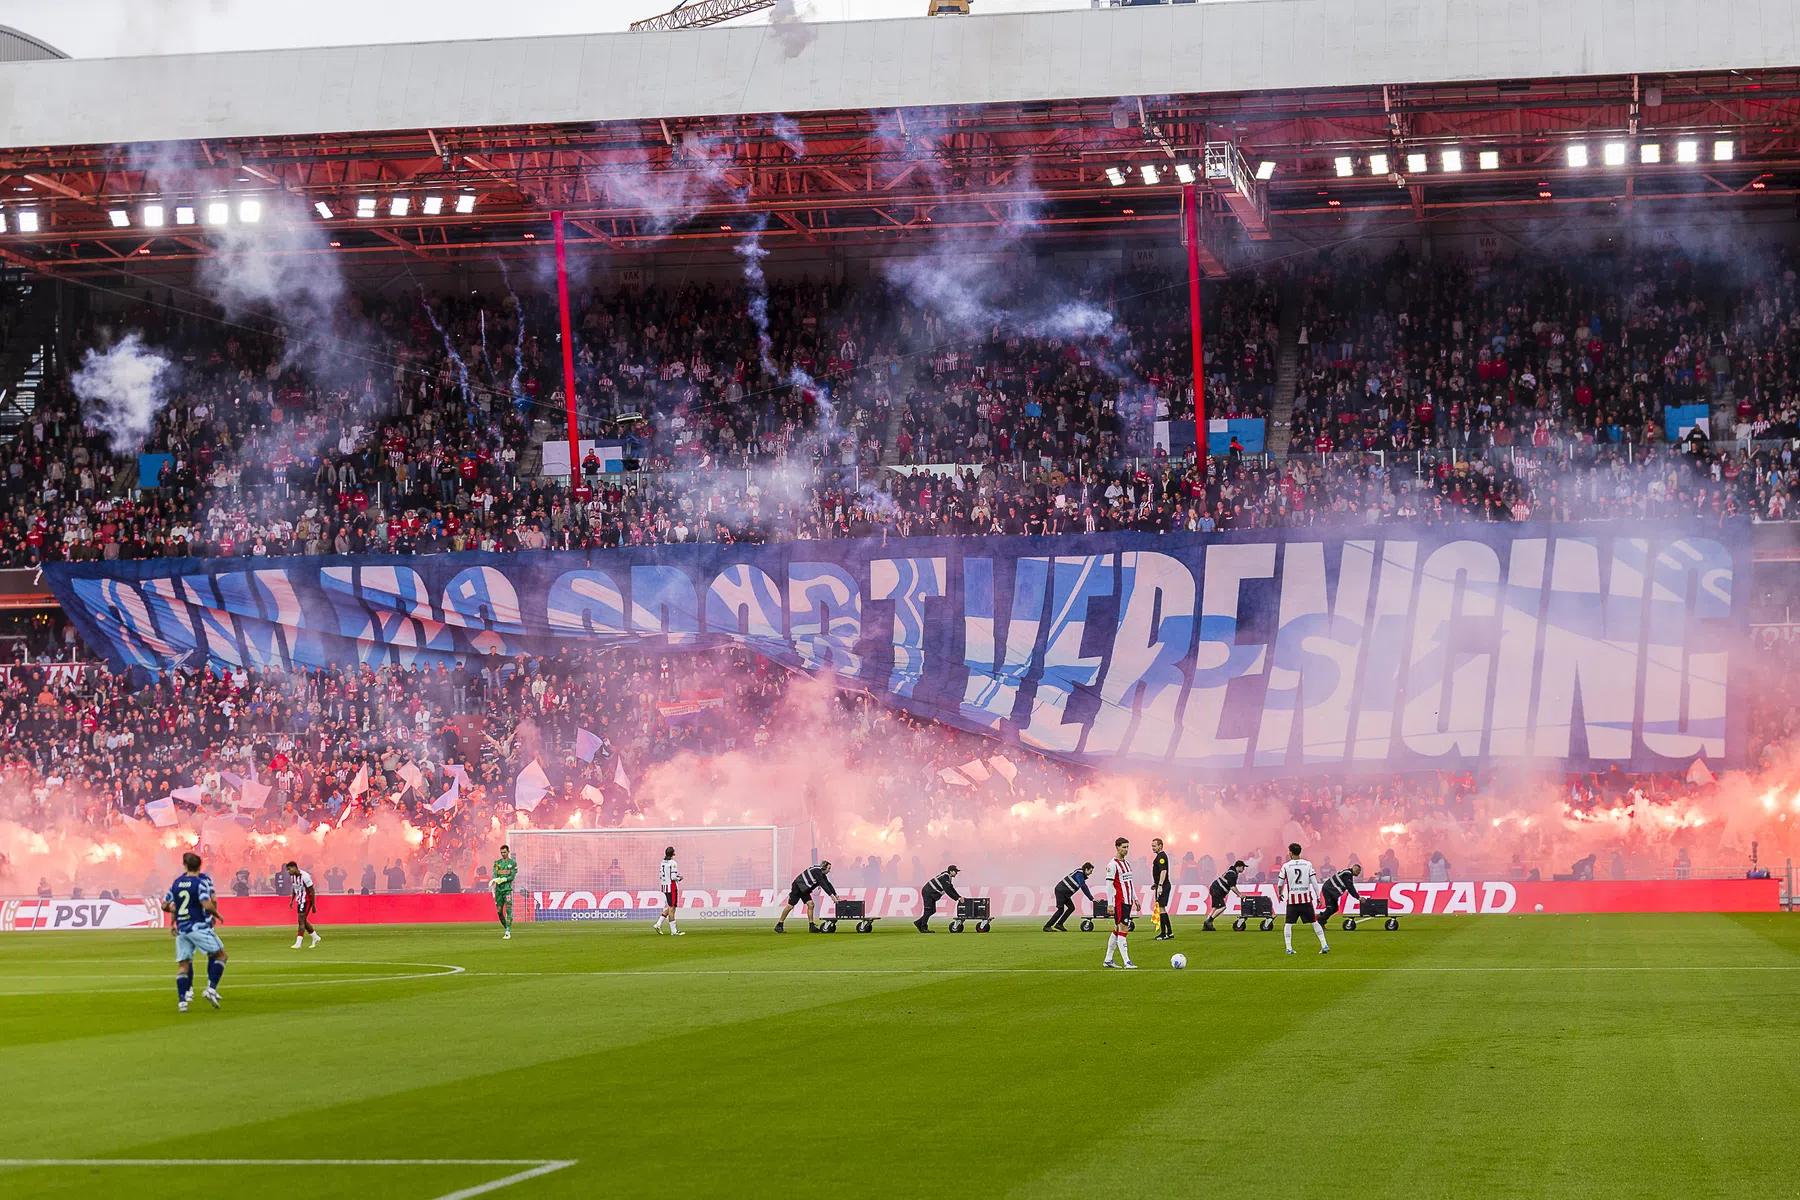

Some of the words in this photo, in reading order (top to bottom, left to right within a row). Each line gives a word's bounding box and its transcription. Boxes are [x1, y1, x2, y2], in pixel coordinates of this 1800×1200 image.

[1479, 237, 1497, 247] VAK
[1137, 250, 1155, 261] VAK
[623, 270, 640, 280] VAK
[959, 537, 1733, 767] VERENIGING
[1294, 868, 1303, 885] 2
[177, 889, 191, 915] 2
[759, 886, 990, 918] KEUREN
[1081, 884, 1211, 916] CUB
[1387, 881, 1517, 914] STAD
[53, 904, 110, 928] PSV
[571, 909, 628, 921] goodhabitz
[699, 908, 756, 920] goodhabitz
